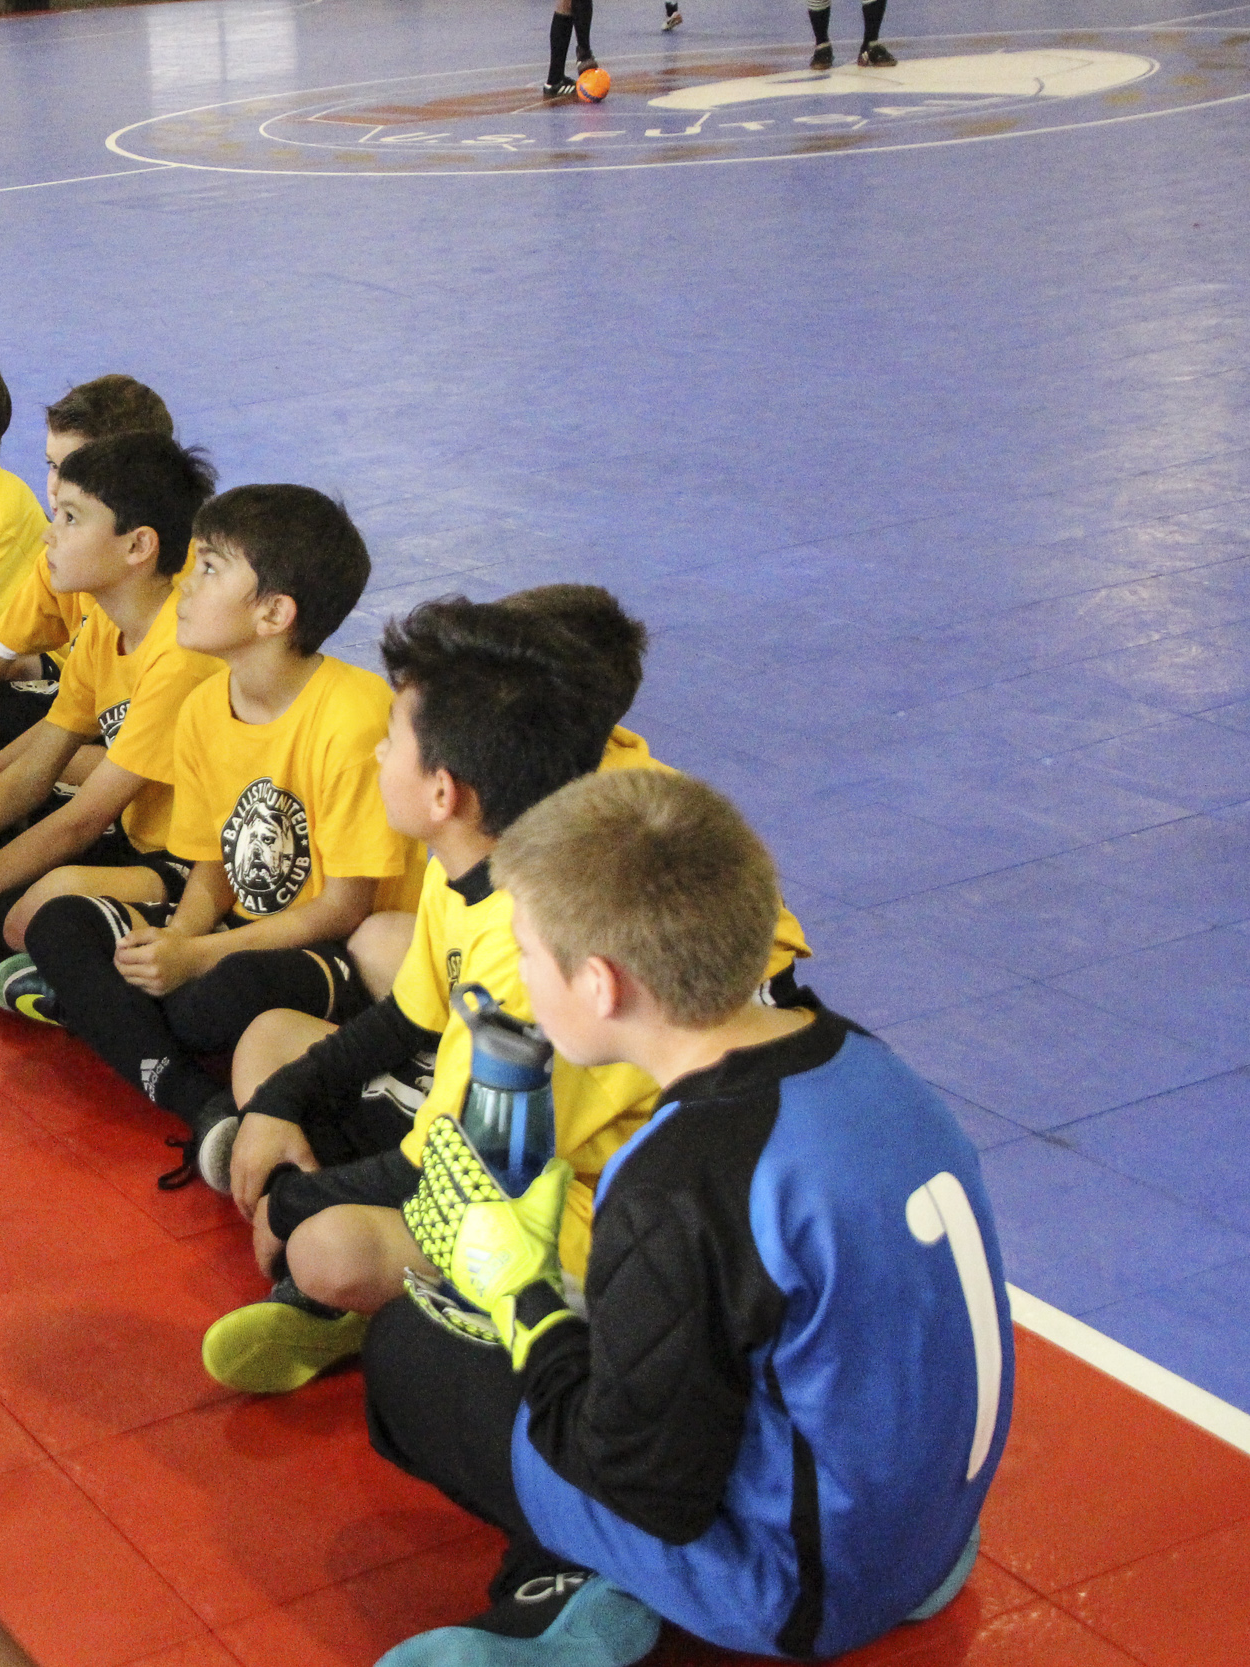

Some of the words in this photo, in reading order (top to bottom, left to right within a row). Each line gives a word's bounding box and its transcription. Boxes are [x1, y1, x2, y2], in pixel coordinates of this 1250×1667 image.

[266, 788, 309, 836] UNITED
[276, 856, 310, 904] CLUB
[905, 1171, 1003, 1481] 1
